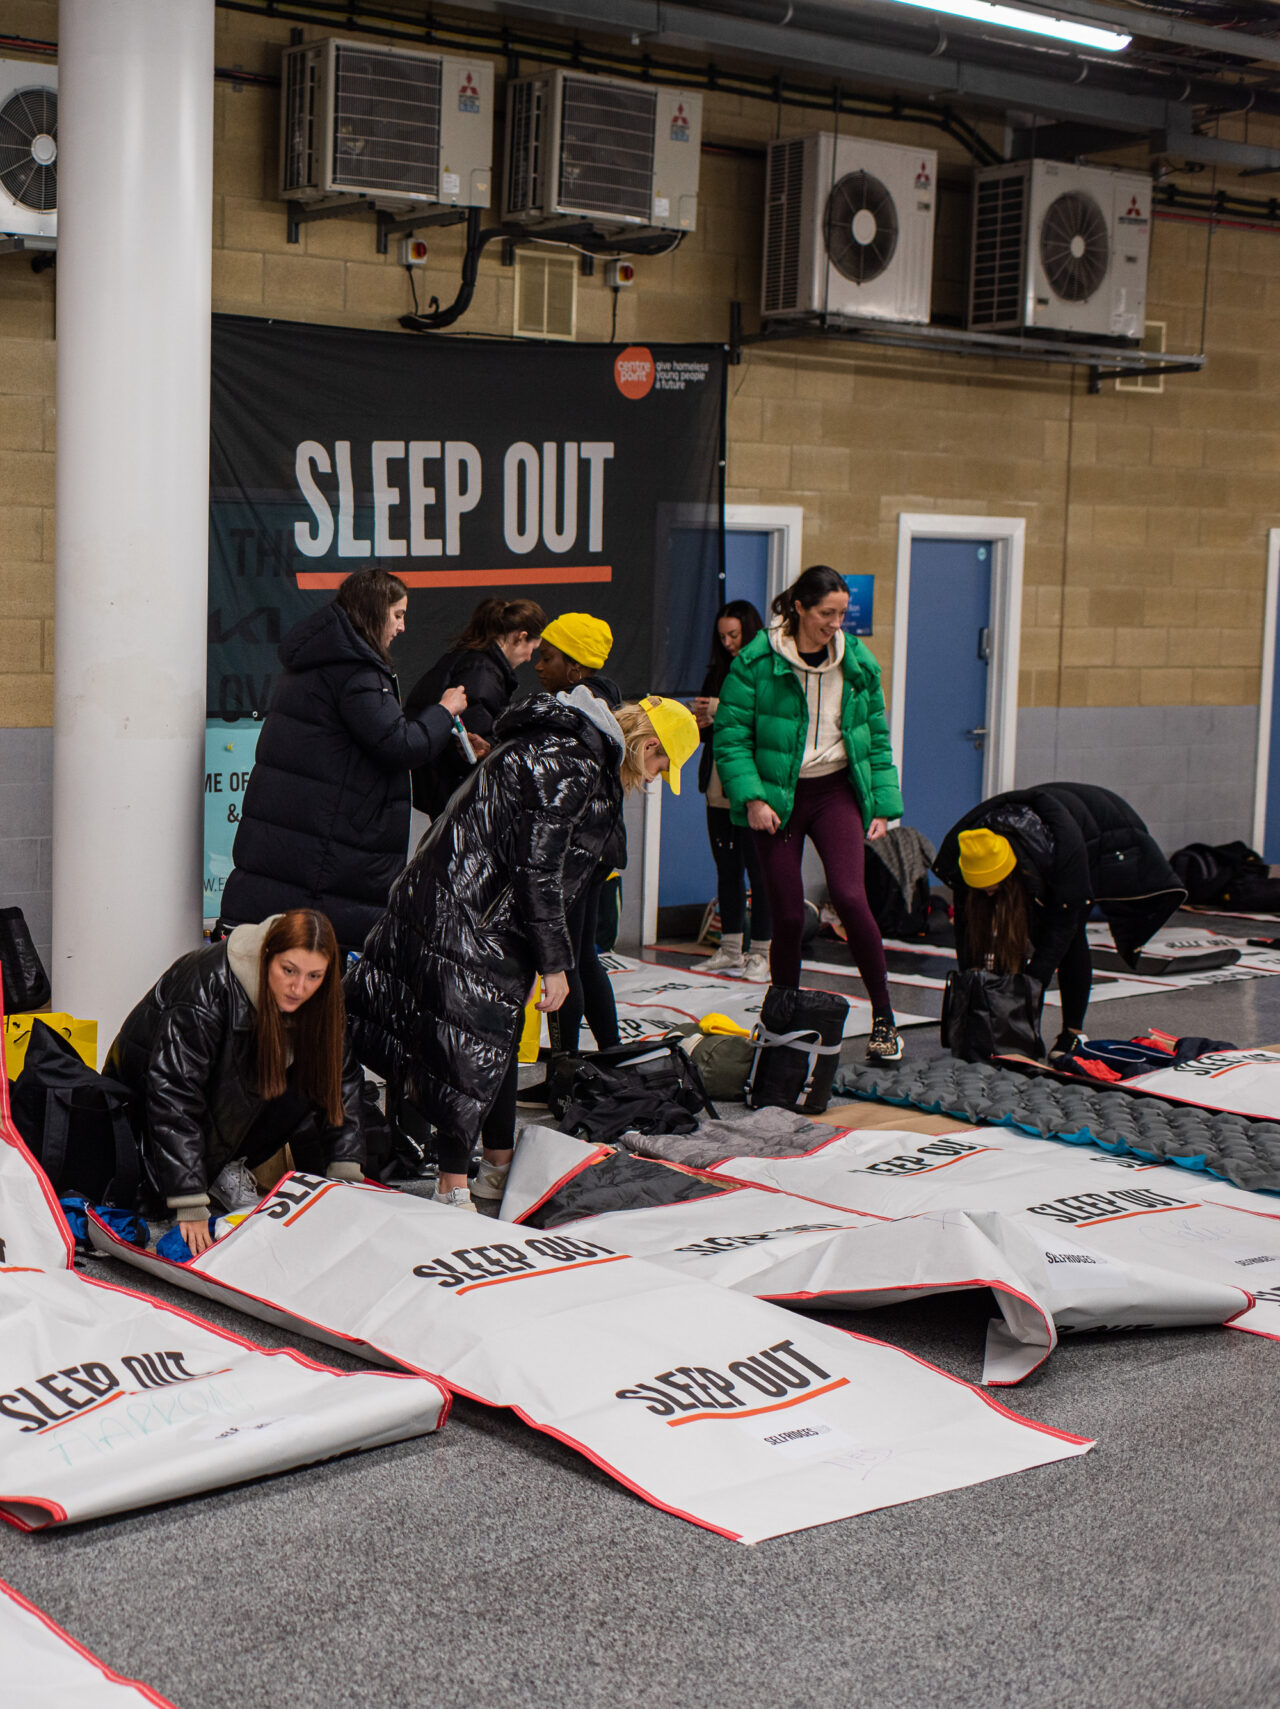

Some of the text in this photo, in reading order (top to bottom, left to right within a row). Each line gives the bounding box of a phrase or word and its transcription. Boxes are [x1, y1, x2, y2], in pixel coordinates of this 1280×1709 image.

[617, 361, 651, 372] centre
[656, 361, 709, 372] give homeless
[621, 371, 647, 382] point
[656, 371, 706, 382] young people
[662, 380, 686, 390] future
[294, 440, 615, 557] SLEEP OUT
[219, 674, 273, 722] OV
[227, 803, 240, 823] &
[1026, 1188, 1186, 1223] SLEEP OUT
[413, 1236, 616, 1287] SLEEP OUT
[1045, 1252, 1097, 1264] SELFRIDGES
[121, 1351, 200, 1389] OUT
[615, 1339, 831, 1416] SLEEP OUT
[764, 1428, 819, 1445] SELFRIDGES
